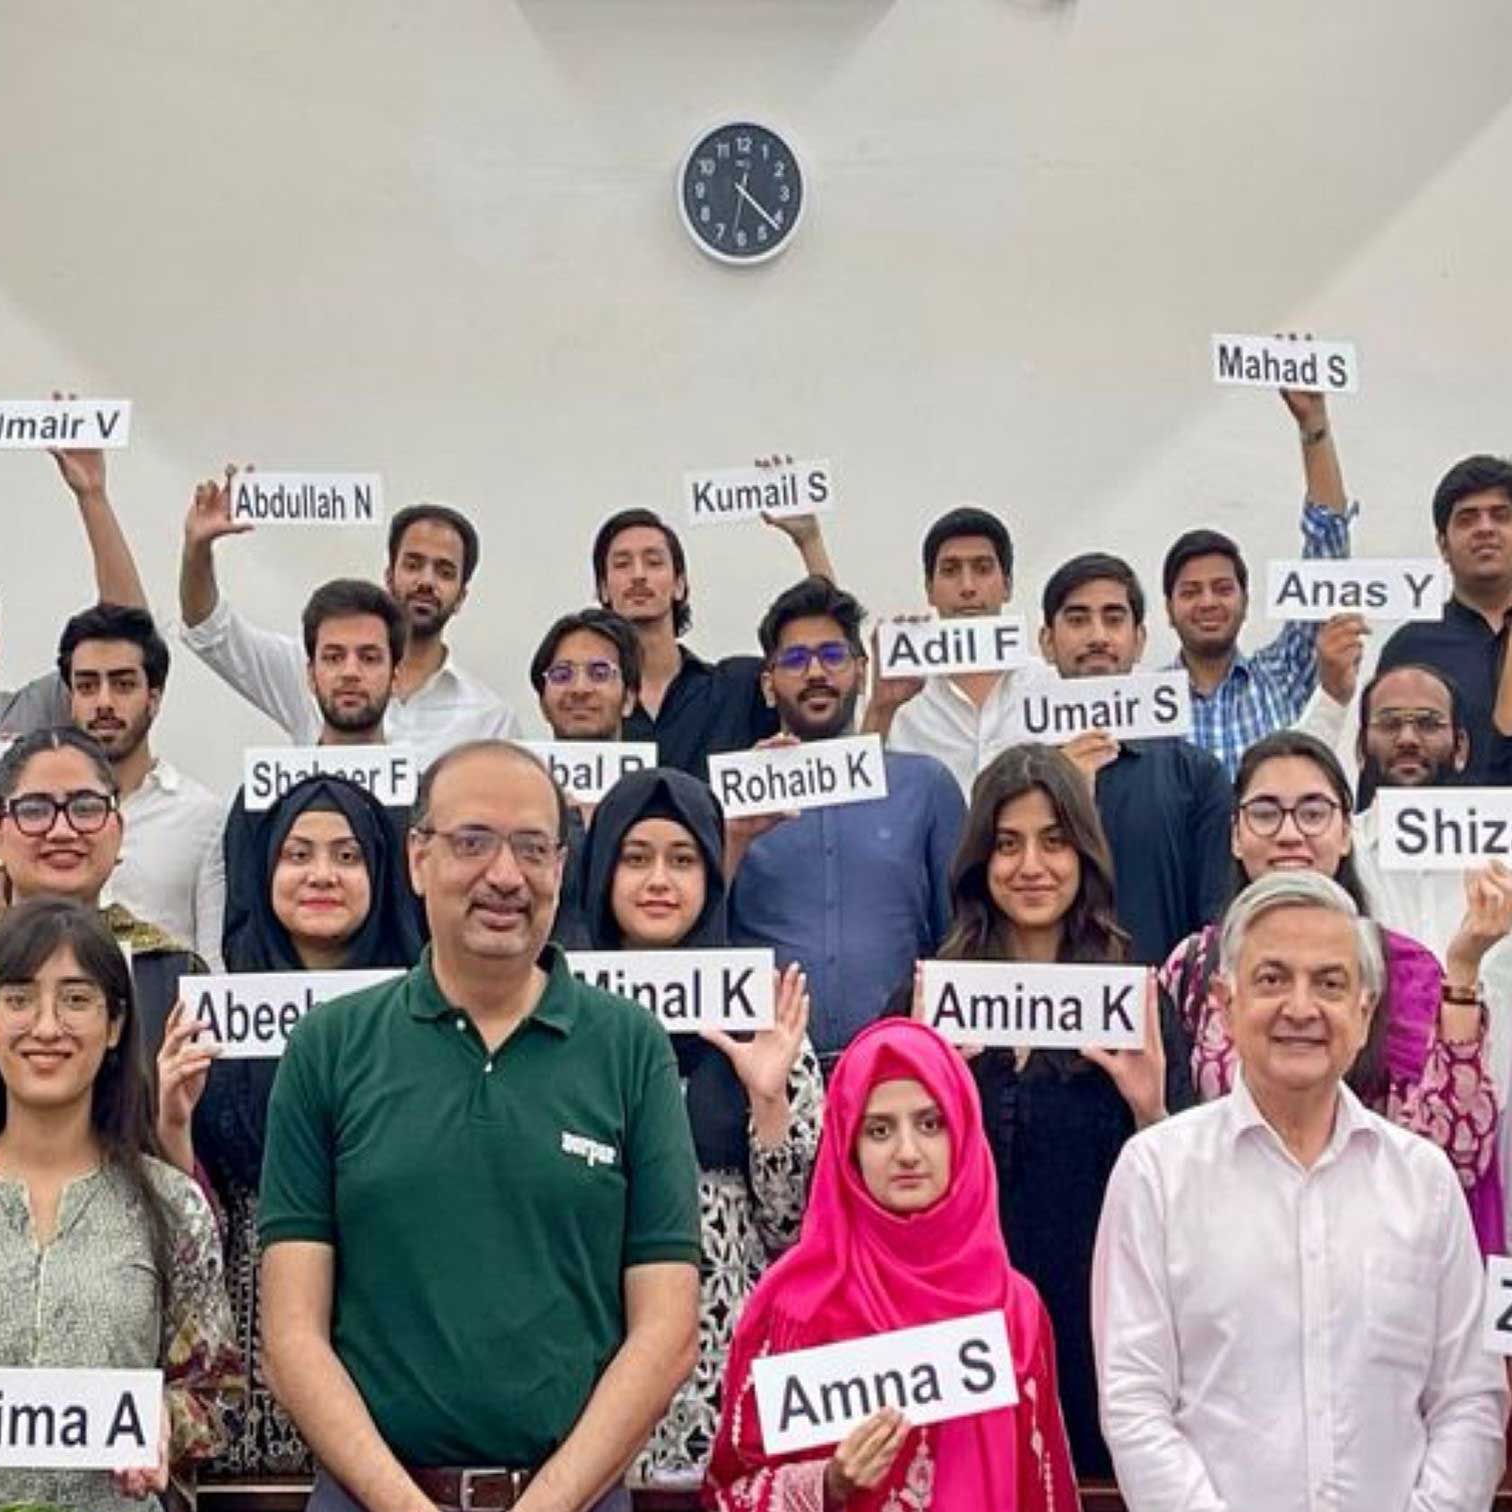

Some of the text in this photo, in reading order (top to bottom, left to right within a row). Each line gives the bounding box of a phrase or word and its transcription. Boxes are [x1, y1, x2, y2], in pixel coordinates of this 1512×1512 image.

[736, 137, 752, 153] 12
[774, 161, 784, 177] 2
[1218, 344, 1348, 388] Mahad S
[96, 411, 120, 439] V
[235, 483, 372, 520] Abdullah N
[692, 471, 828, 512] Kumail S
[1276, 571, 1434, 608] Anas Y
[887, 626, 1020, 668] Adil F
[1023, 685, 1179, 733] Umair S
[390, 758, 408, 795] F
[721, 750, 872, 806] Rohaib K
[722, 968, 756, 1018] K
[933, 982, 1135, 1032] Amina K
[190, 988, 314, 1044] Abee
[779, 1339, 997, 1432] Amna S
[105, 1391, 146, 1447] A
